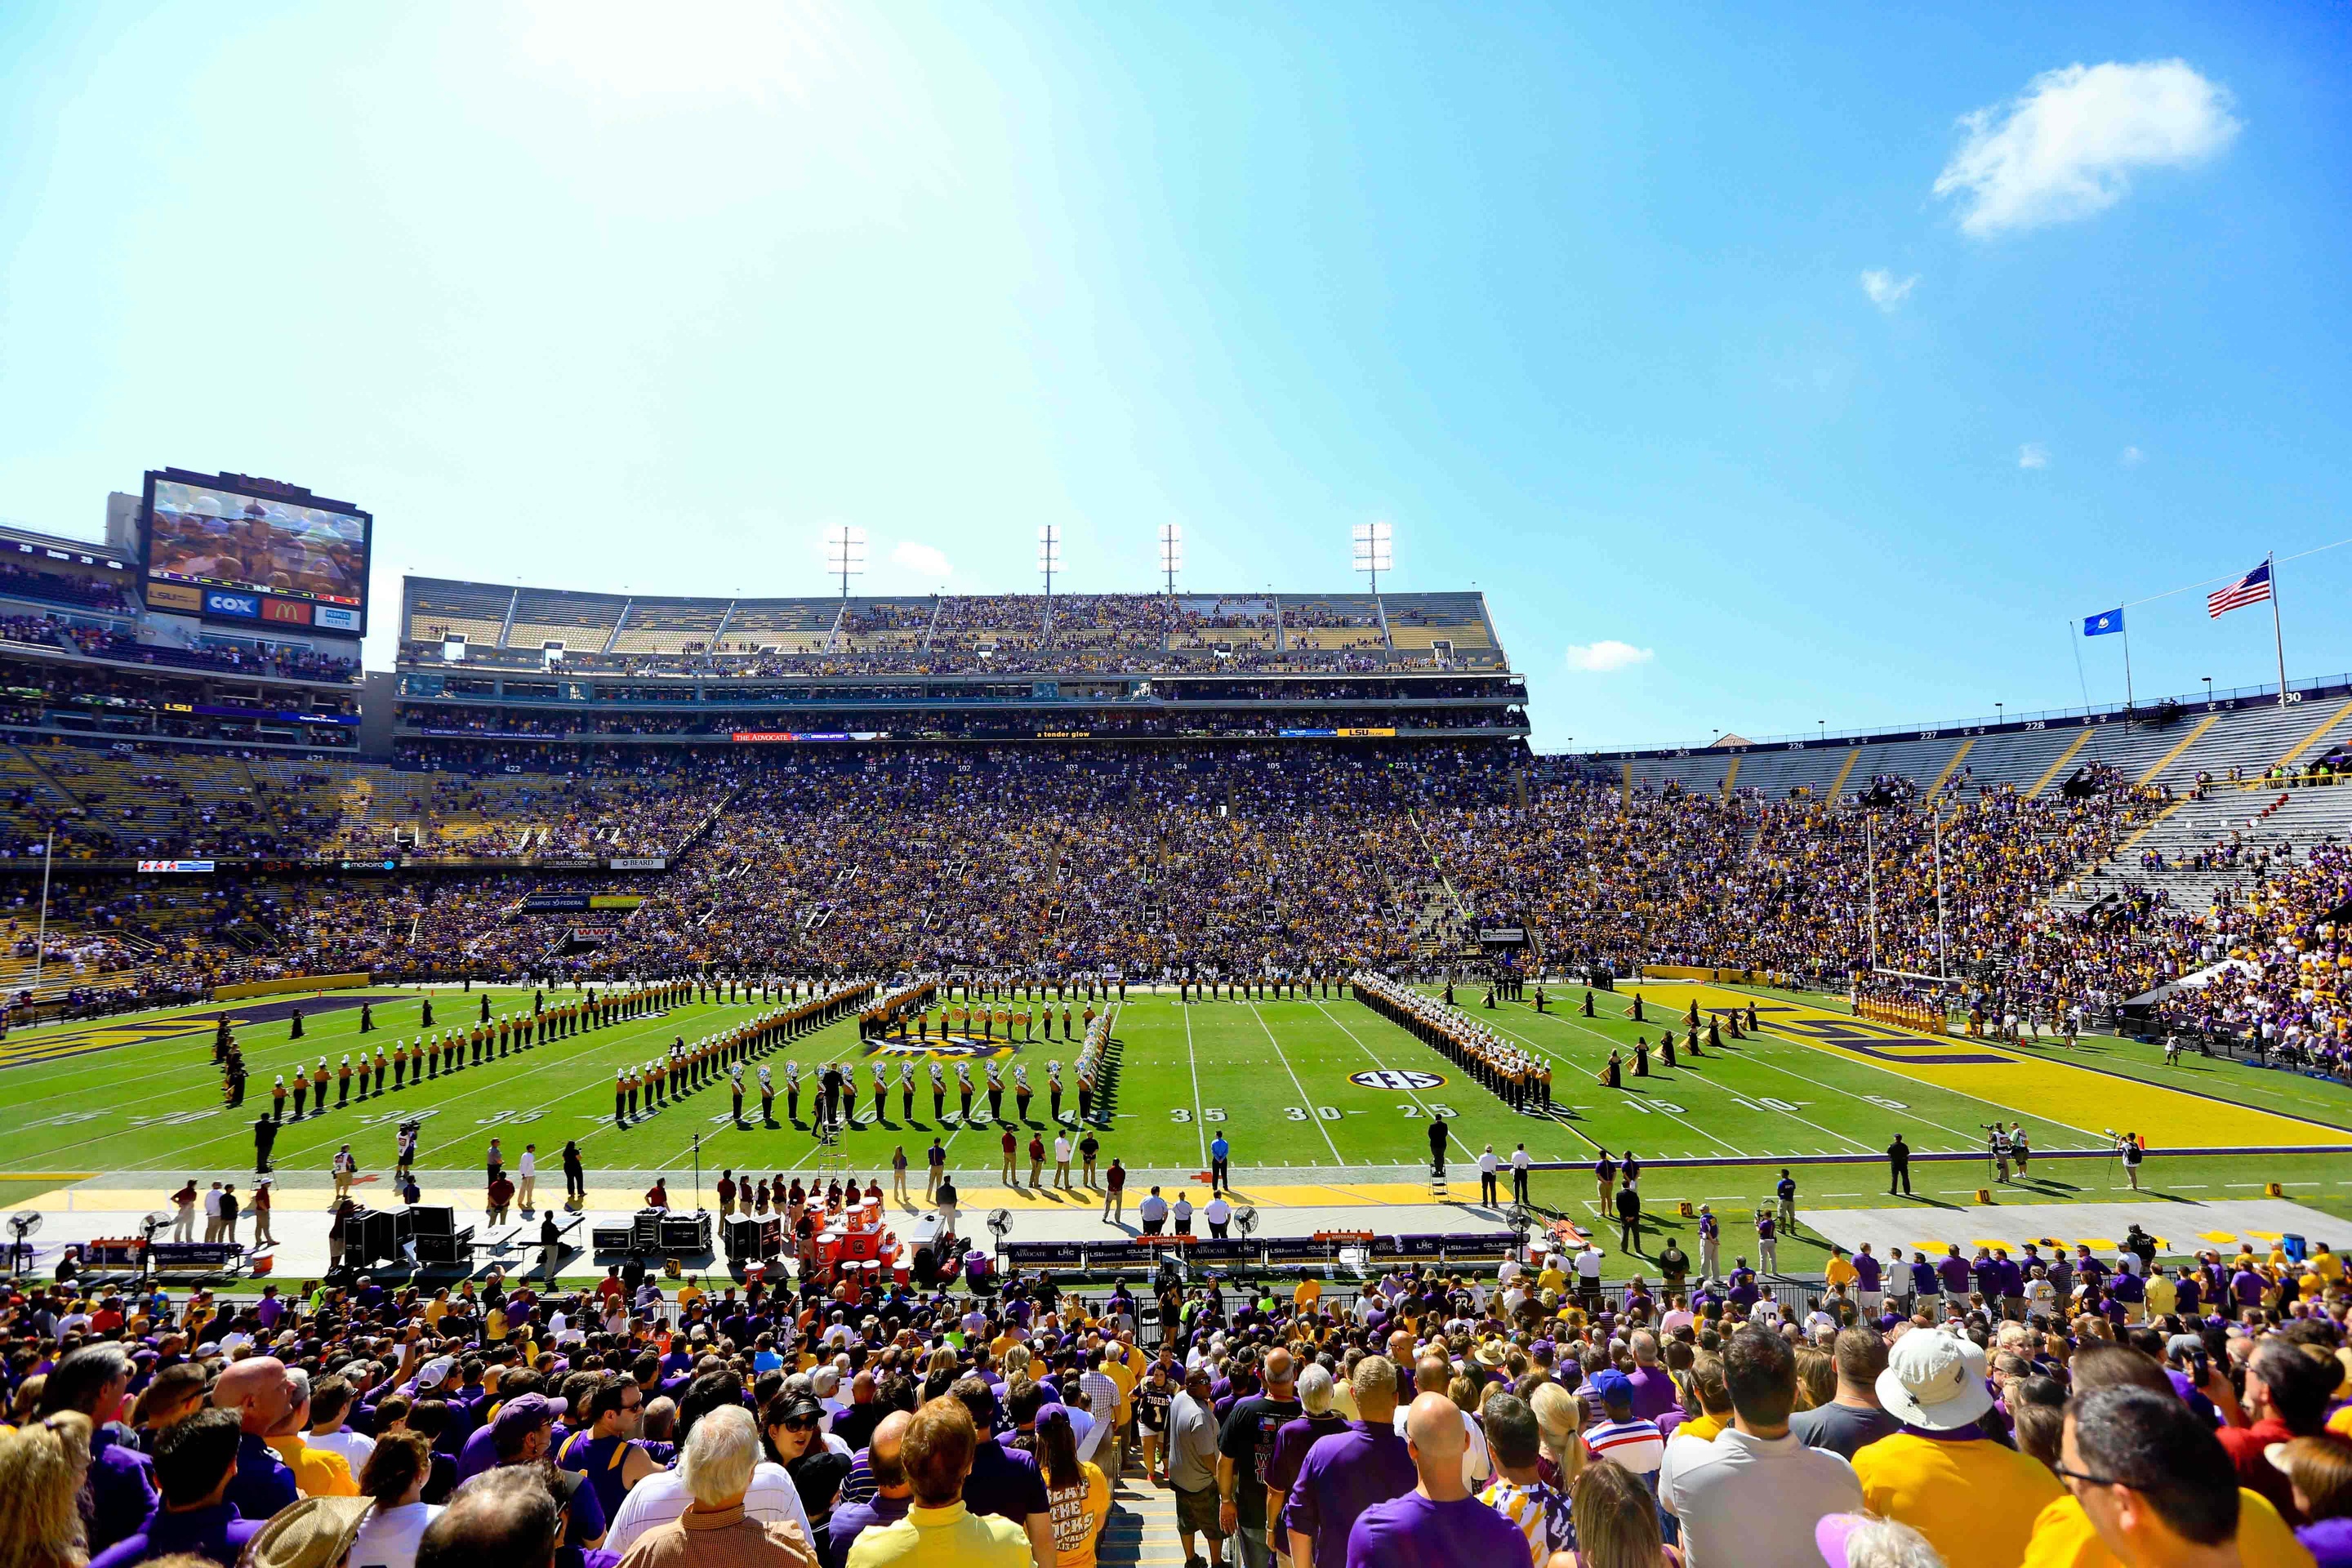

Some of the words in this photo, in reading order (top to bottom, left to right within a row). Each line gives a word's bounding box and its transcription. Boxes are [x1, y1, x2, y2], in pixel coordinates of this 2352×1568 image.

[149, 590, 176, 600] LSU
[165, 703, 192, 712] LSU
[2025, 721, 2045, 731] 228
[1920, 732, 1937, 740] 227
[112, 743, 133, 751] 420
[1621, 1099, 1686, 1114] 15
[1730, 1097, 1802, 1111] 10
[1860, 1095, 1911, 1109] 5
[361, 1110, 441, 1124] 30
[474, 1110, 553, 1125] 35
[707, 1110, 764, 1124] 45
[942, 1109, 995, 1124] 45
[1170, 1108, 1227, 1123] 35
[1283, 1107, 1342, 1121] 30
[1396, 1104, 1459, 1119] 25
[1980, 1189, 1990, 1202] 10
[2272, 1183, 2280, 1196] G
[1681, 1202, 1693, 1216] 20
[818, 1245, 824, 1254] G
[666, 1259, 677, 1273] 50
[750, 1273, 758, 1281] G
[1147, 1395, 1169, 1406] TIGERS
[1153, 1405, 1162, 1423] 1
[1049, 1500, 1081, 1521] THE
[1052, 1512, 1094, 1539] OCKS
[1065, 1526, 1093, 1543] VALLEY
